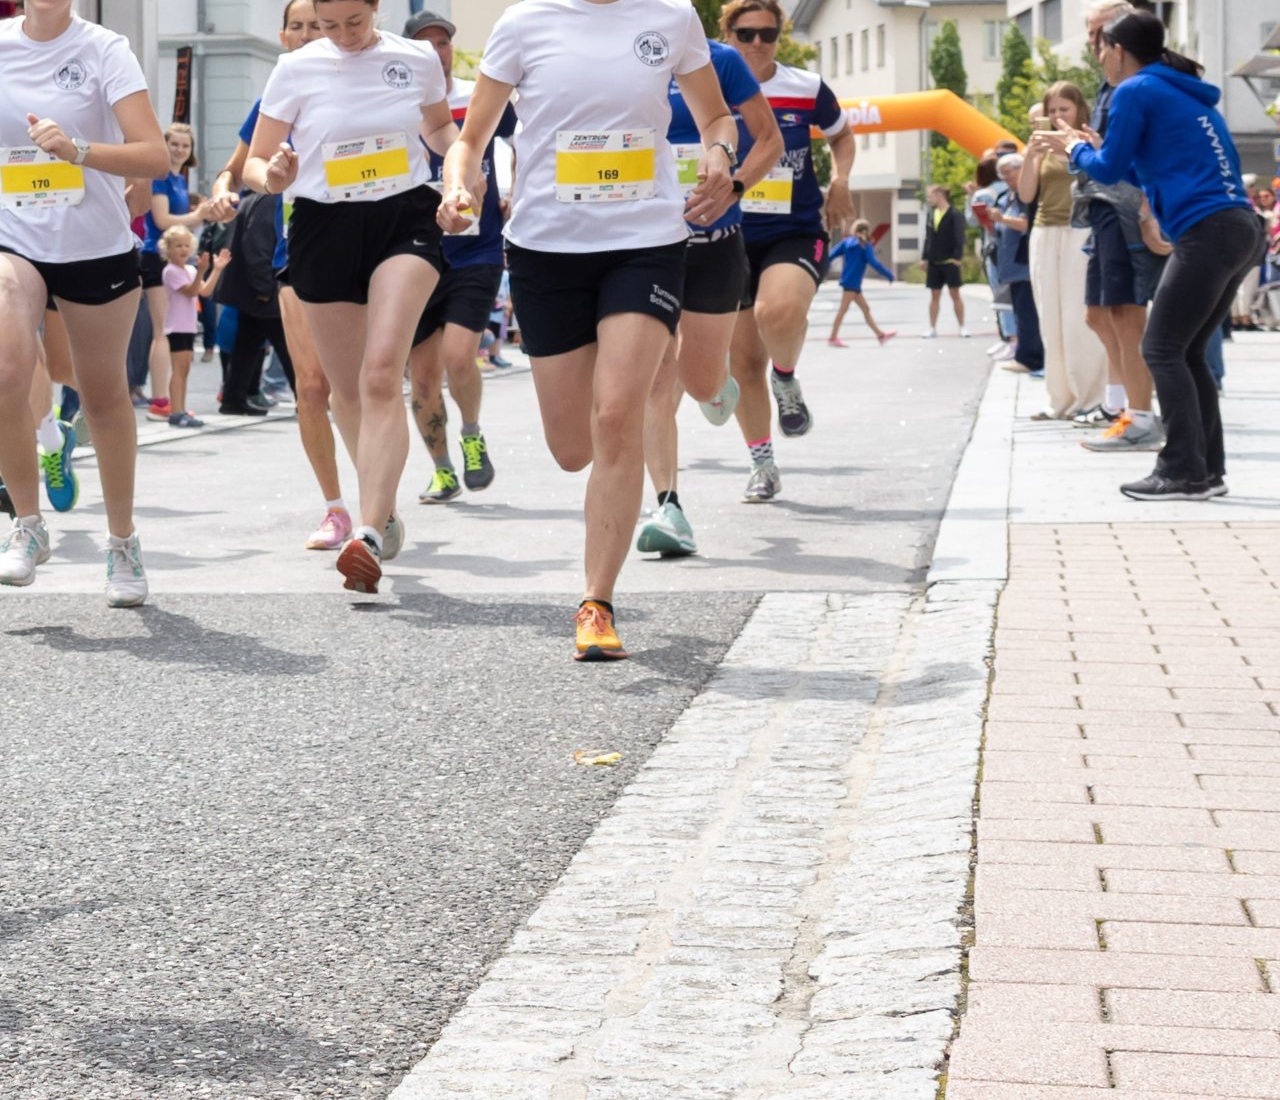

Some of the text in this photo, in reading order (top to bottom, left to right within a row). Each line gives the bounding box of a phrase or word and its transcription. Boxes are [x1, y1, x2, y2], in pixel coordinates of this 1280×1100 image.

[360, 168, 377, 180] 171
[597, 169, 619, 180] 169
[32, 178, 50, 189] 170
